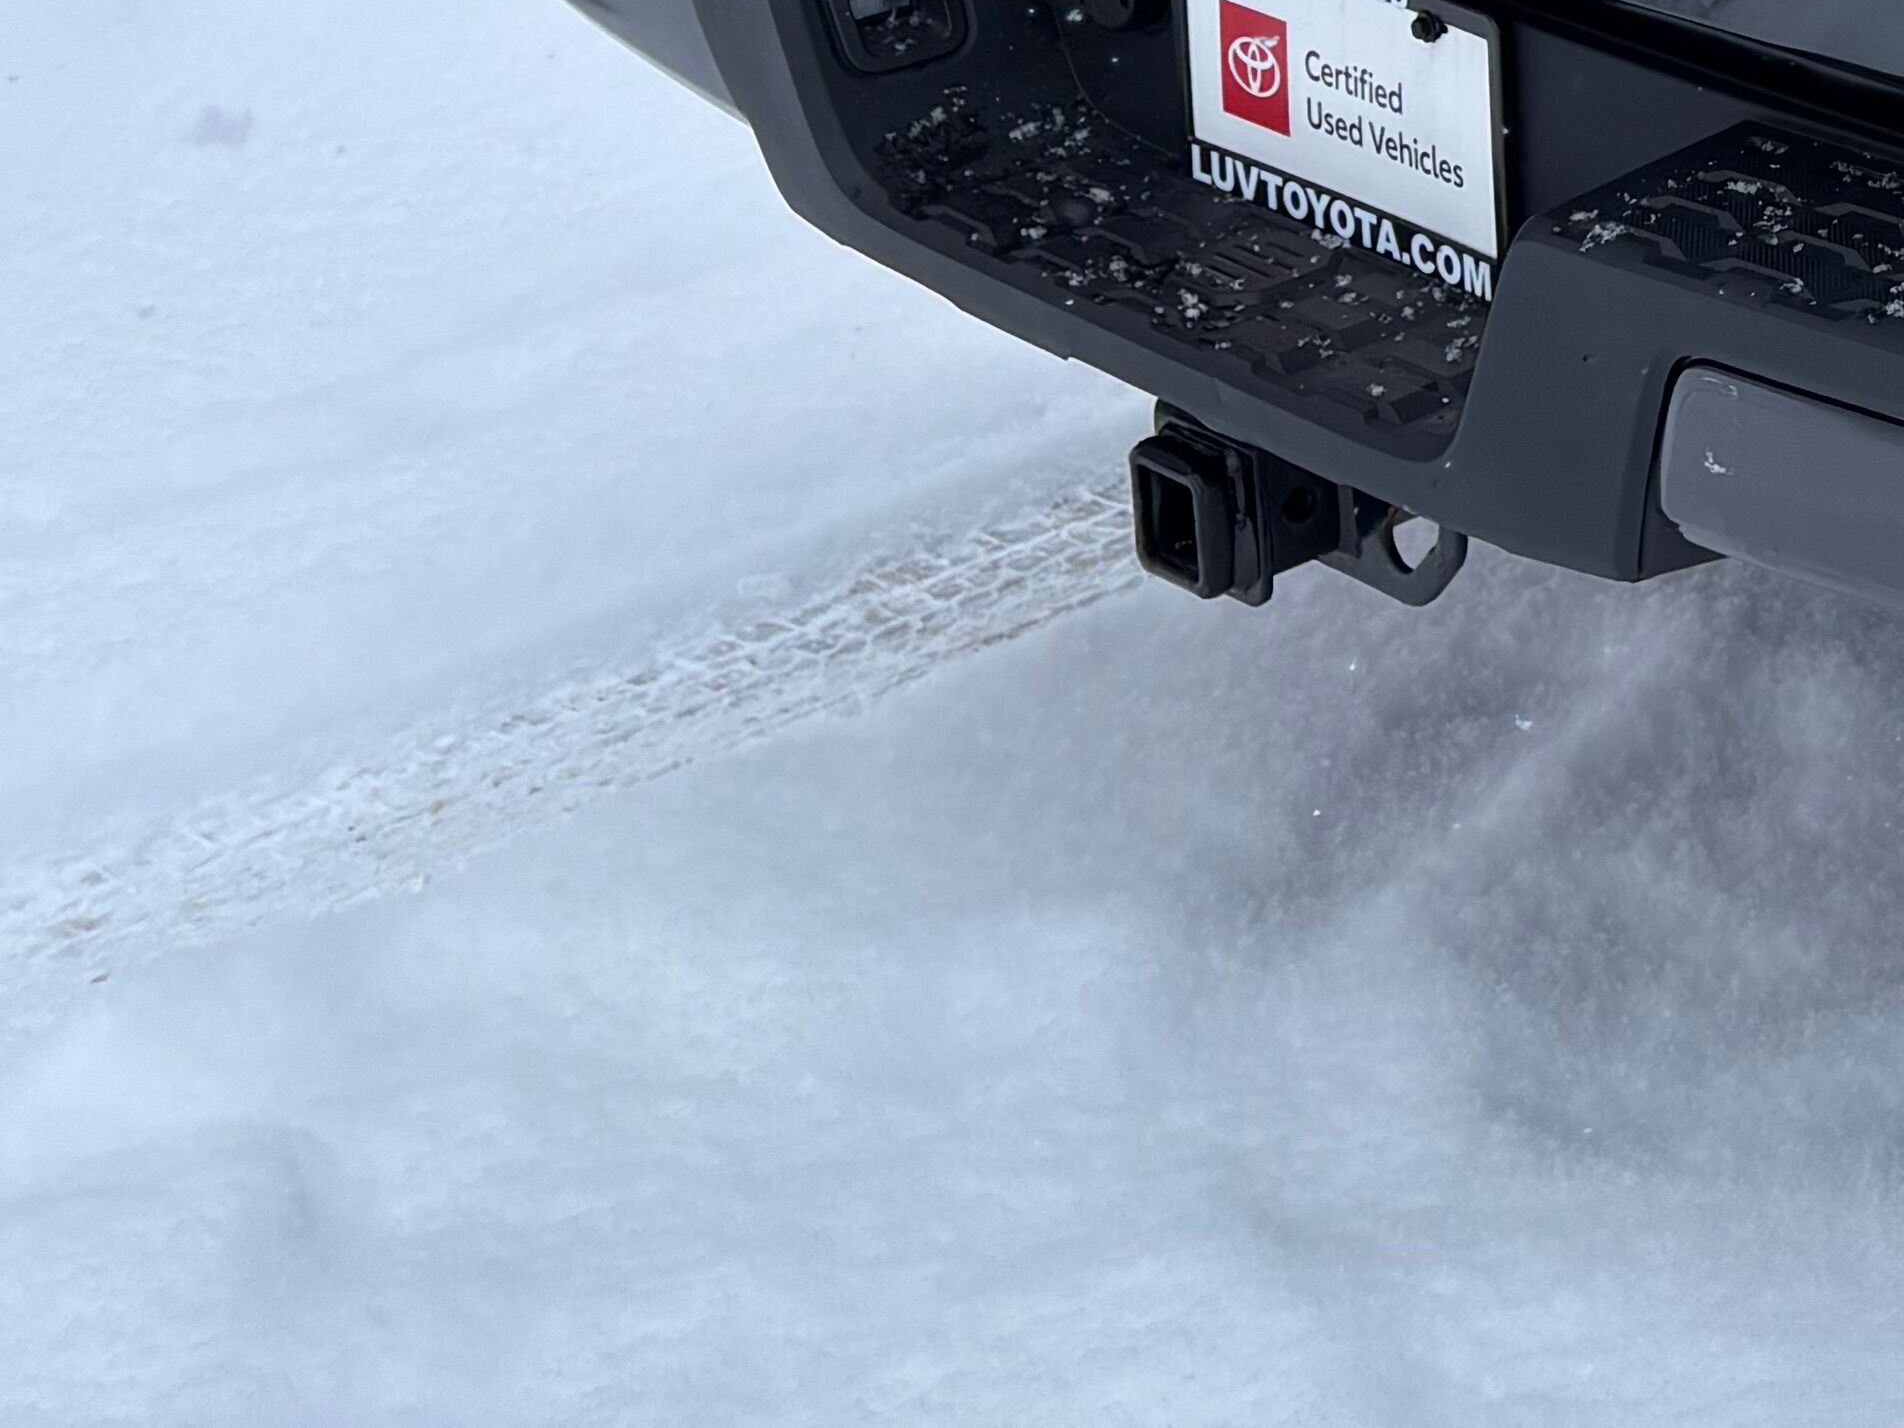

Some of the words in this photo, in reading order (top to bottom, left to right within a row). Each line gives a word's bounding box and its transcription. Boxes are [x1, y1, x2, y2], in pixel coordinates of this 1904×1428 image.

[1304, 49, 1404, 115] Certified
[1306, 95, 1364, 148] Used
[1368, 120, 1465, 189] Vehicles
[1190, 143, 1493, 303] LUVTOYOTA.COM
